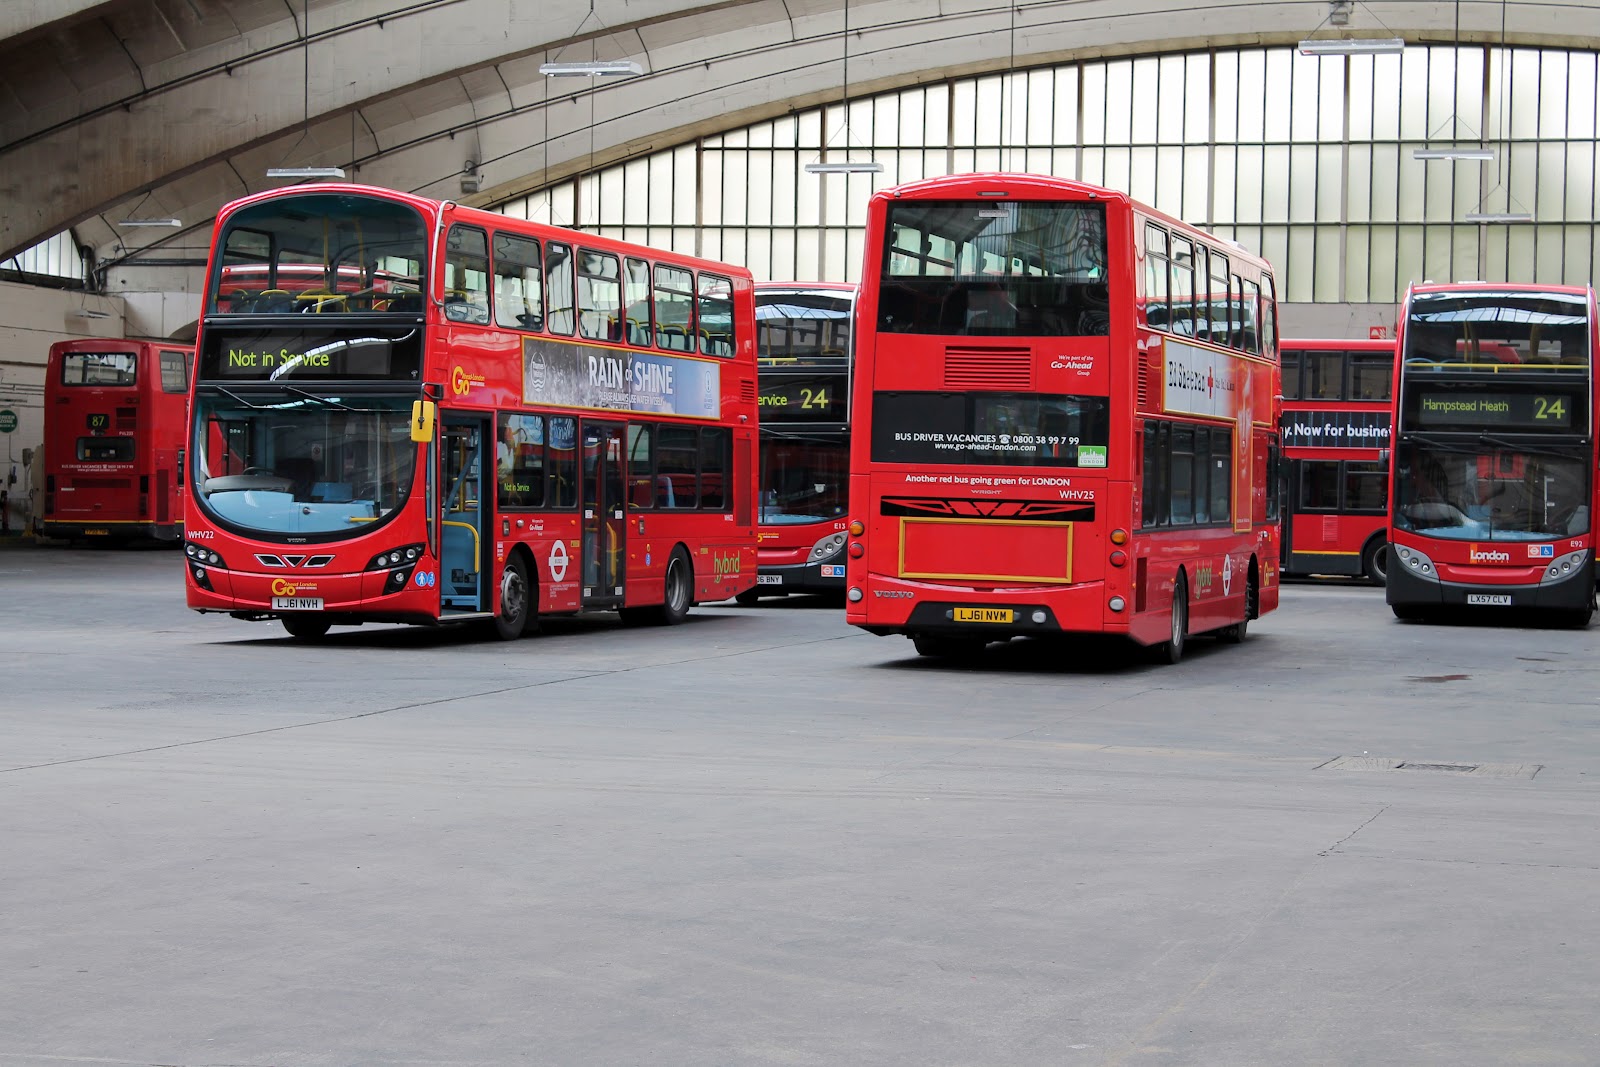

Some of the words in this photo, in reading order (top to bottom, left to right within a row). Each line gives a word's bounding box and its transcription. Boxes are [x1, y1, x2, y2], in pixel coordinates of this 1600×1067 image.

[229, 349, 257, 367] Not
[262, 350, 274, 367] in
[1050, 361, 1093, 370] Go-Ahead
[588, 355, 623, 389] RAIN
[634, 361, 674, 395] SHINE
[800, 388, 829, 409] 24
[1423, 398, 1476, 414] Hampstead
[1480, 400, 1508, 412] Heath
[1534, 397, 1566, 419] 24
[92, 416, 105, 427] 87
[1294, 423, 1322, 436] Now
[1324, 423, 1344, 436] for
[1346, 424, 1391, 438] busine
[895, 432, 912, 440] BUS
[914, 434, 944, 442] DRIVER
[946, 434, 996, 443] VACANCIES
[1012, 436, 1034, 444] 0800
[1036, 436, 1046, 444] 38
[1048, 436, 1059, 444] 99
[1068, 437, 1080, 445] 99
[934, 443, 1036, 452] www.go-ahead-london.com
[905, 474, 938, 482] Another
[954, 476, 968, 484] bus
[970, 476, 992, 486] going
[1018, 477, 1030, 486] for
[1032, 478, 1070, 486] LONDON
[516, 482, 530, 492] Service
[1059, 490, 1095, 500] WHV25
[188, 530, 214, 539] WHV22
[1470, 549, 1510, 561] London
[714, 550, 740, 584] hybrid
[272, 578, 296, 596] Go
[874, 590, 914, 598] VOLVO
[1470, 595, 1491, 603] LX57
[278, 599, 298, 608] LJ61
[300, 600, 318, 608] NVH
[960, 610, 984, 620] LJ61
[986, 610, 1007, 621] NVM
